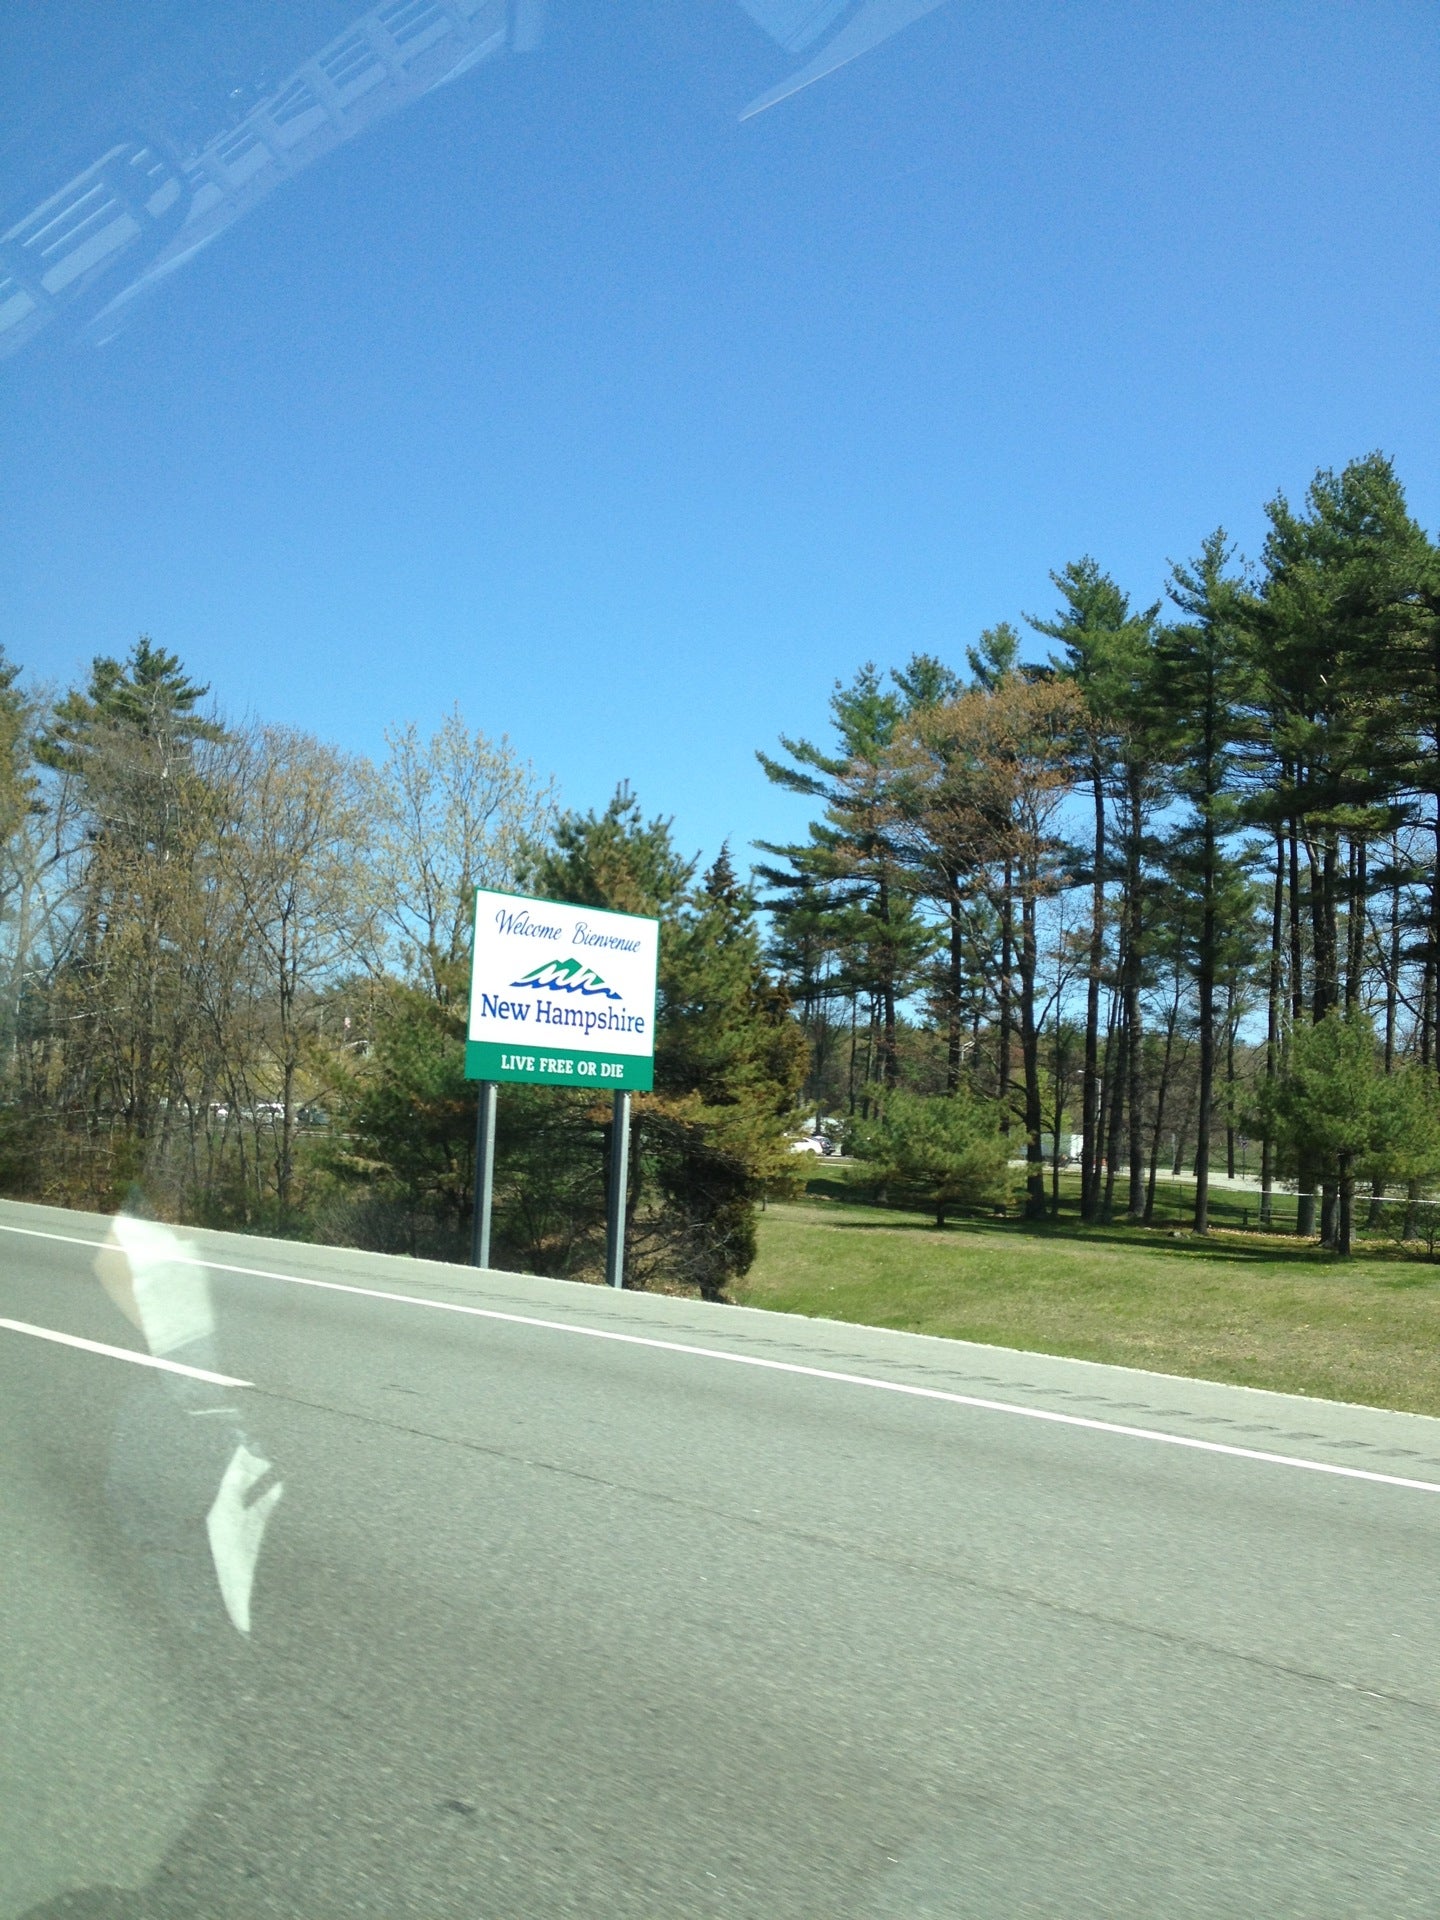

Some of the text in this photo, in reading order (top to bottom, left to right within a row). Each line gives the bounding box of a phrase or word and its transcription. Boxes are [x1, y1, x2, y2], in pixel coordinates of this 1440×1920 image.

[495, 908, 641, 953] Welcome Bienvenue
[480, 993, 645, 1035] New Hampshire
[501, 1054, 624, 1078] LIVE FREE OR DIE
